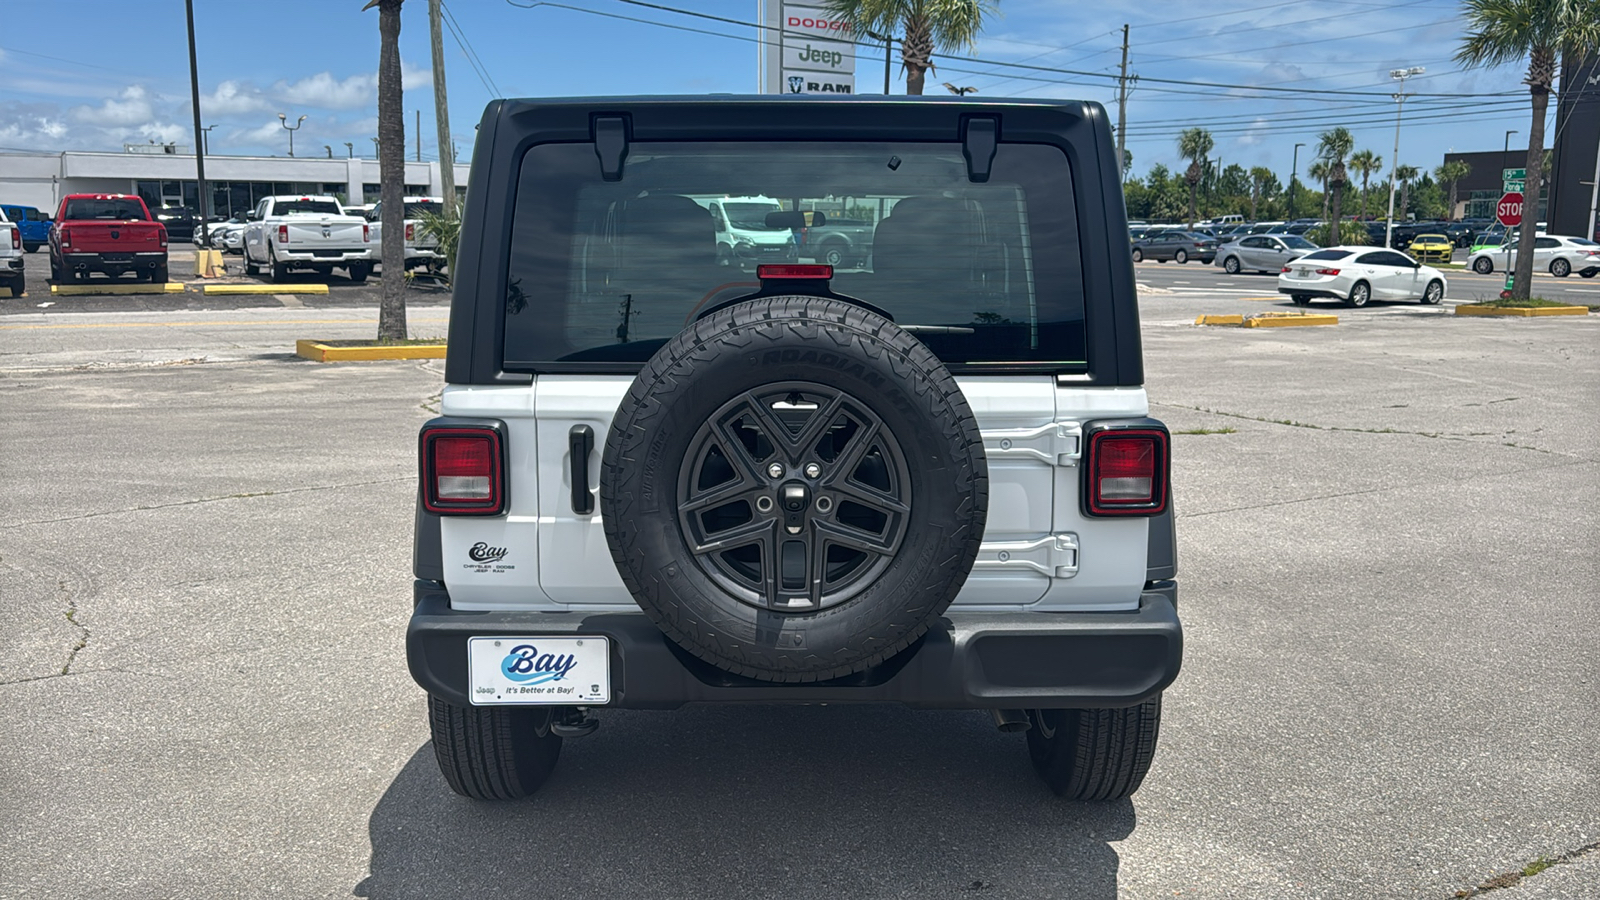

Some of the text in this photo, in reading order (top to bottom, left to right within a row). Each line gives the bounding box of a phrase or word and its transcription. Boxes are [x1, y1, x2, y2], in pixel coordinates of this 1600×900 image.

[788, 17, 852, 31] DODGE
[799, 44, 842, 68] Jeep
[807, 82, 851, 94] RAM
[762, 349, 886, 389] ROADIAN
[469, 541, 509, 562] Bay
[505, 644, 578, 682] Bay
[520, 686, 545, 694] Better
[546, 686, 556, 694] at
[556, 686, 575, 695] Bay!
